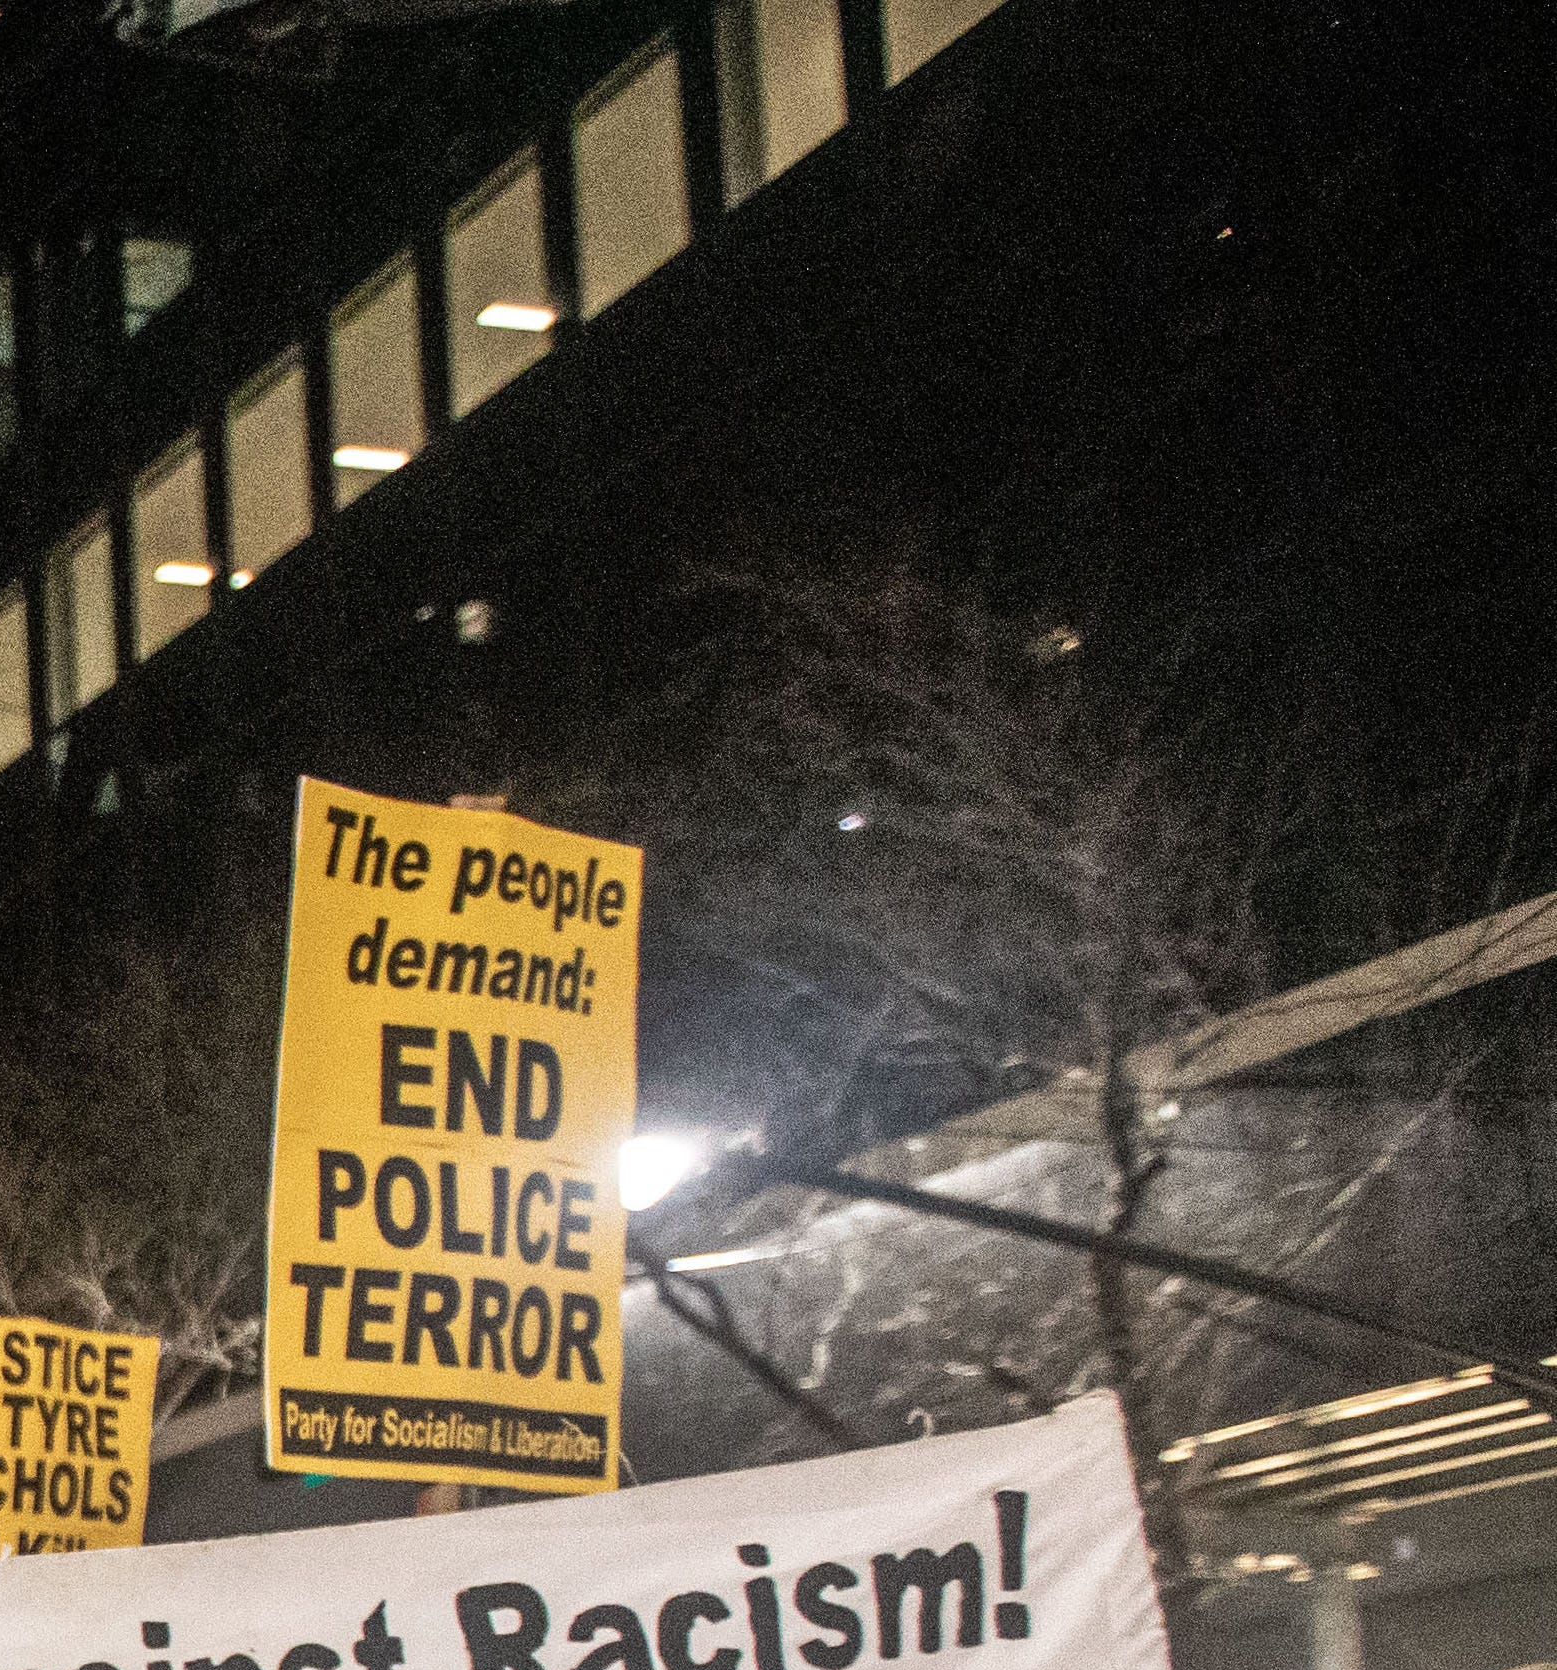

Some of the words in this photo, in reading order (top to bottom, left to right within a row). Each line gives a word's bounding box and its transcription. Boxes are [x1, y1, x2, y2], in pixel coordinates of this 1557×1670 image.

[325, 805, 432, 892] The
[450, 844, 626, 934] people
[347, 917, 596, 1016] demand:
[380, 1022, 564, 1143] END
[318, 1148, 596, 1273] POLICE
[290, 1262, 605, 1386] TERROR
[3, 1393, 120, 1460] TYRE
[285, 1402, 338, 1451] Party
[342, 1406, 377, 1445] for
[382, 1408, 488, 1452] Socialism
[506, 1416, 600, 1462] Liberation
